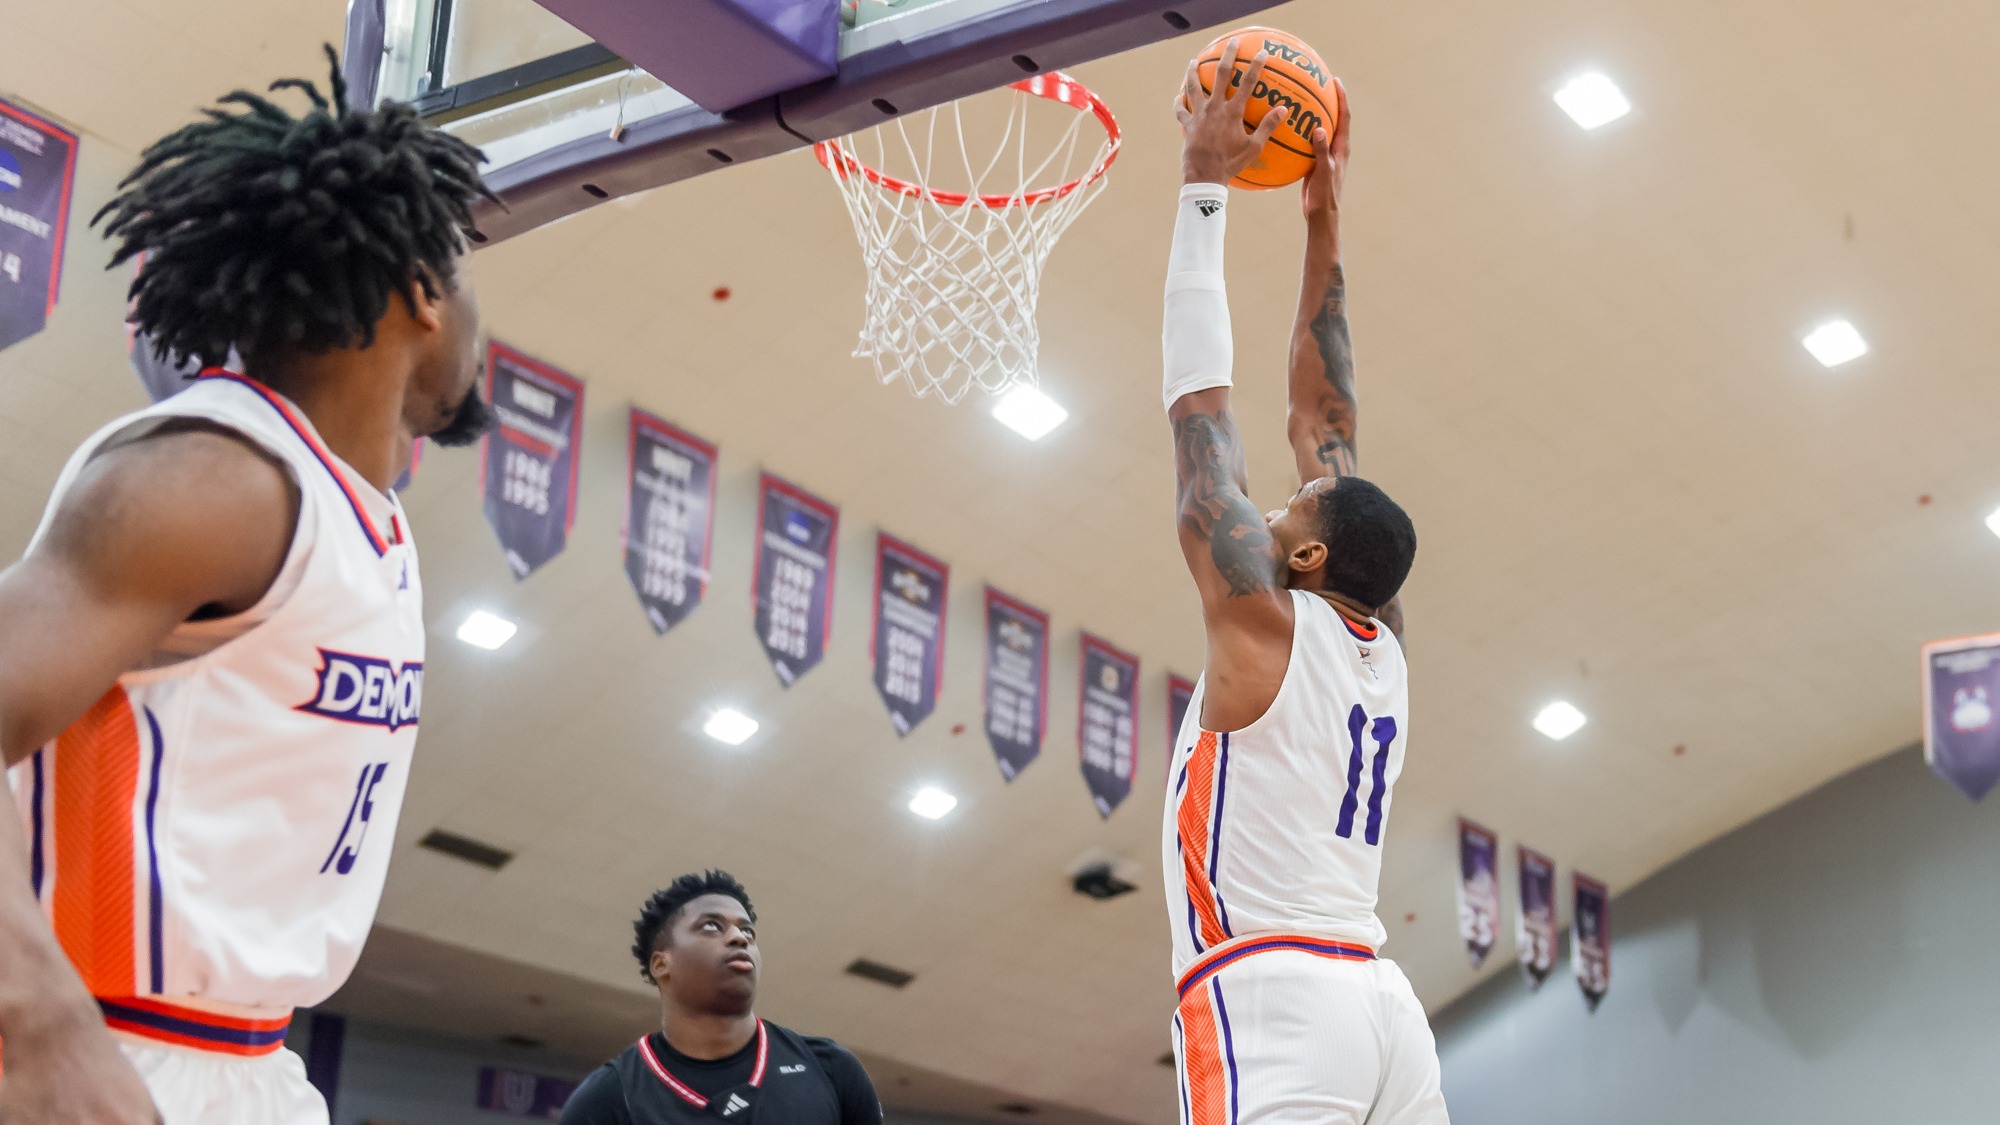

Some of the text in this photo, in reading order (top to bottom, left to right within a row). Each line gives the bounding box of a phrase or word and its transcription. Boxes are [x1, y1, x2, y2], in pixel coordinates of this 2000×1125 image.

[1263, 39, 1328, 88] NCAA
[319, 762, 389, 875] 15
[1335, 703, 1397, 846] 11
